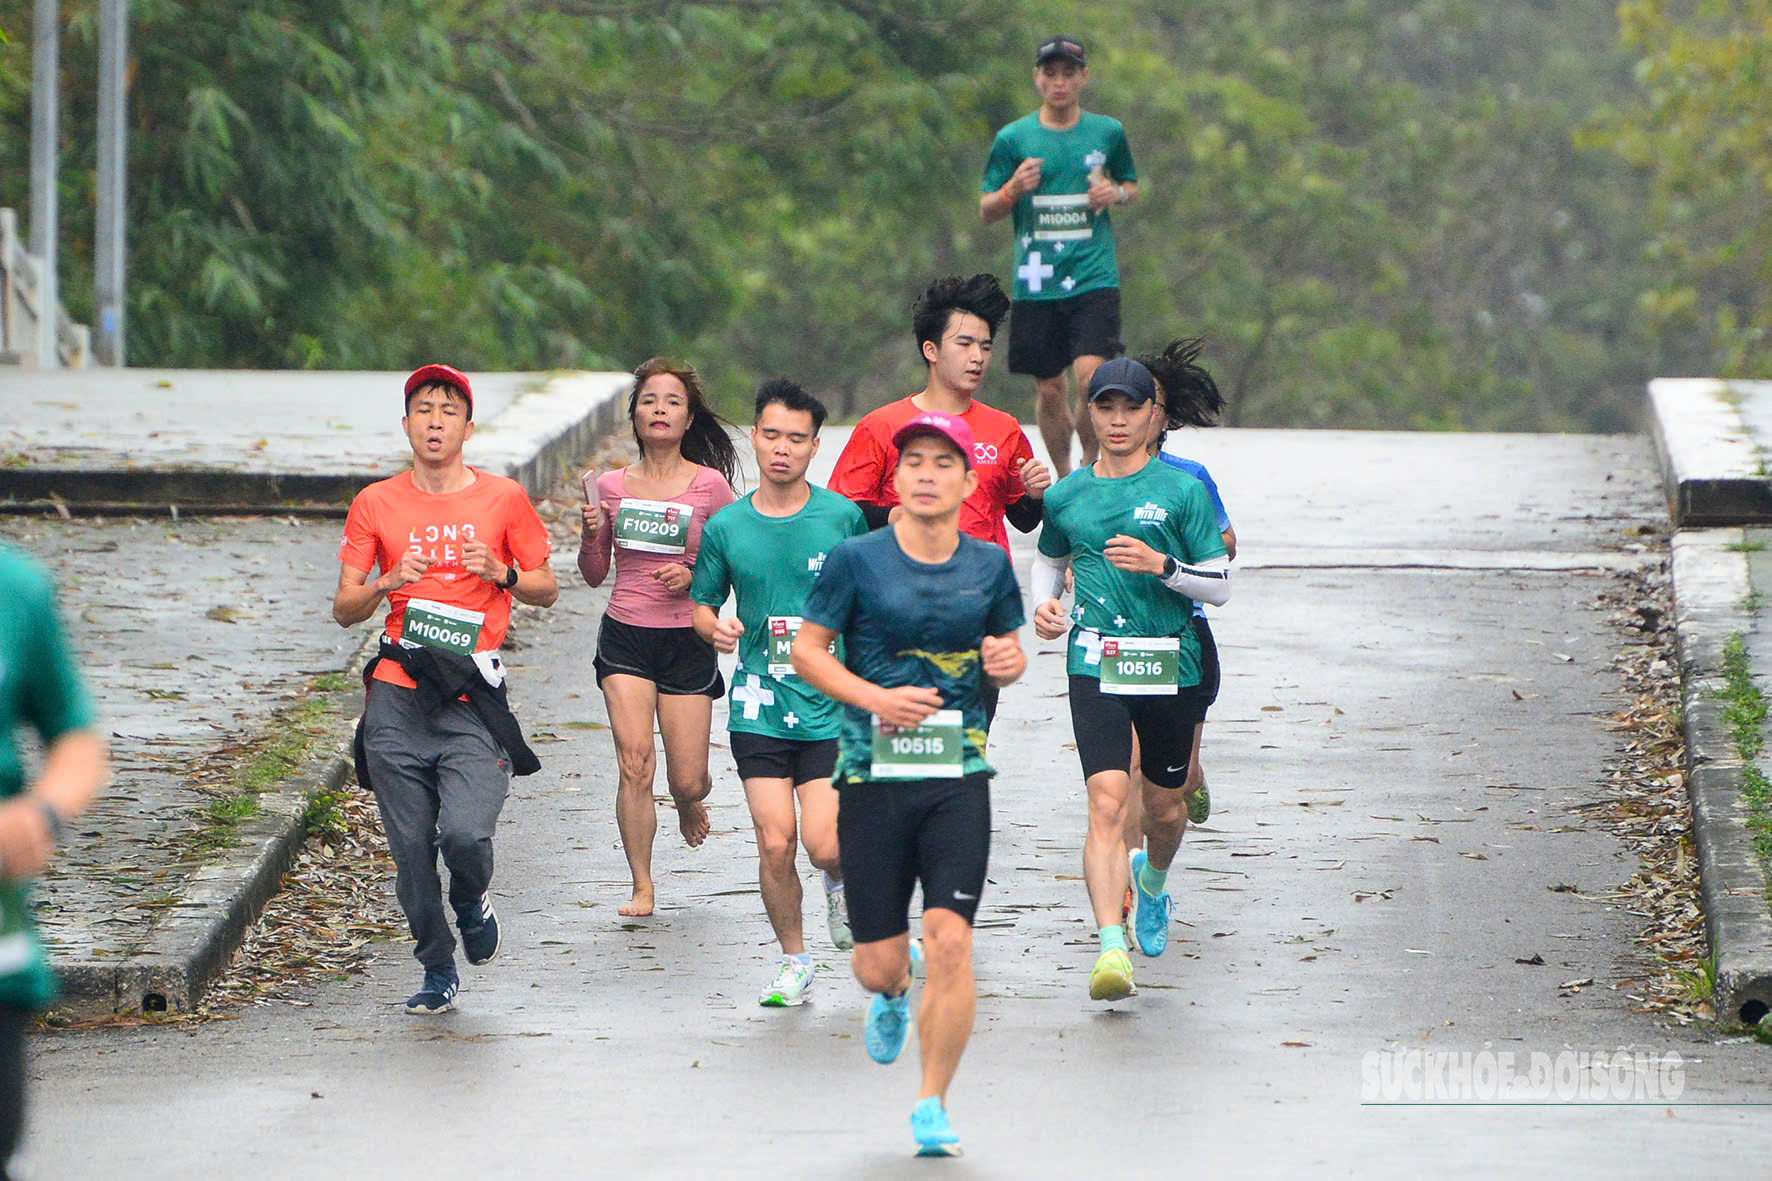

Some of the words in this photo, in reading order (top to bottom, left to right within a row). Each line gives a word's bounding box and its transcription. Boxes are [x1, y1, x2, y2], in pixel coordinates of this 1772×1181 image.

[1039, 212, 1087, 224] M10004
[973, 443, 998, 460] 30
[409, 524, 475, 542] LONG
[623, 517, 680, 537] F10209
[409, 620, 471, 647] M10069
[1116, 661, 1163, 675] 10516
[891, 737, 944, 754] 10515
